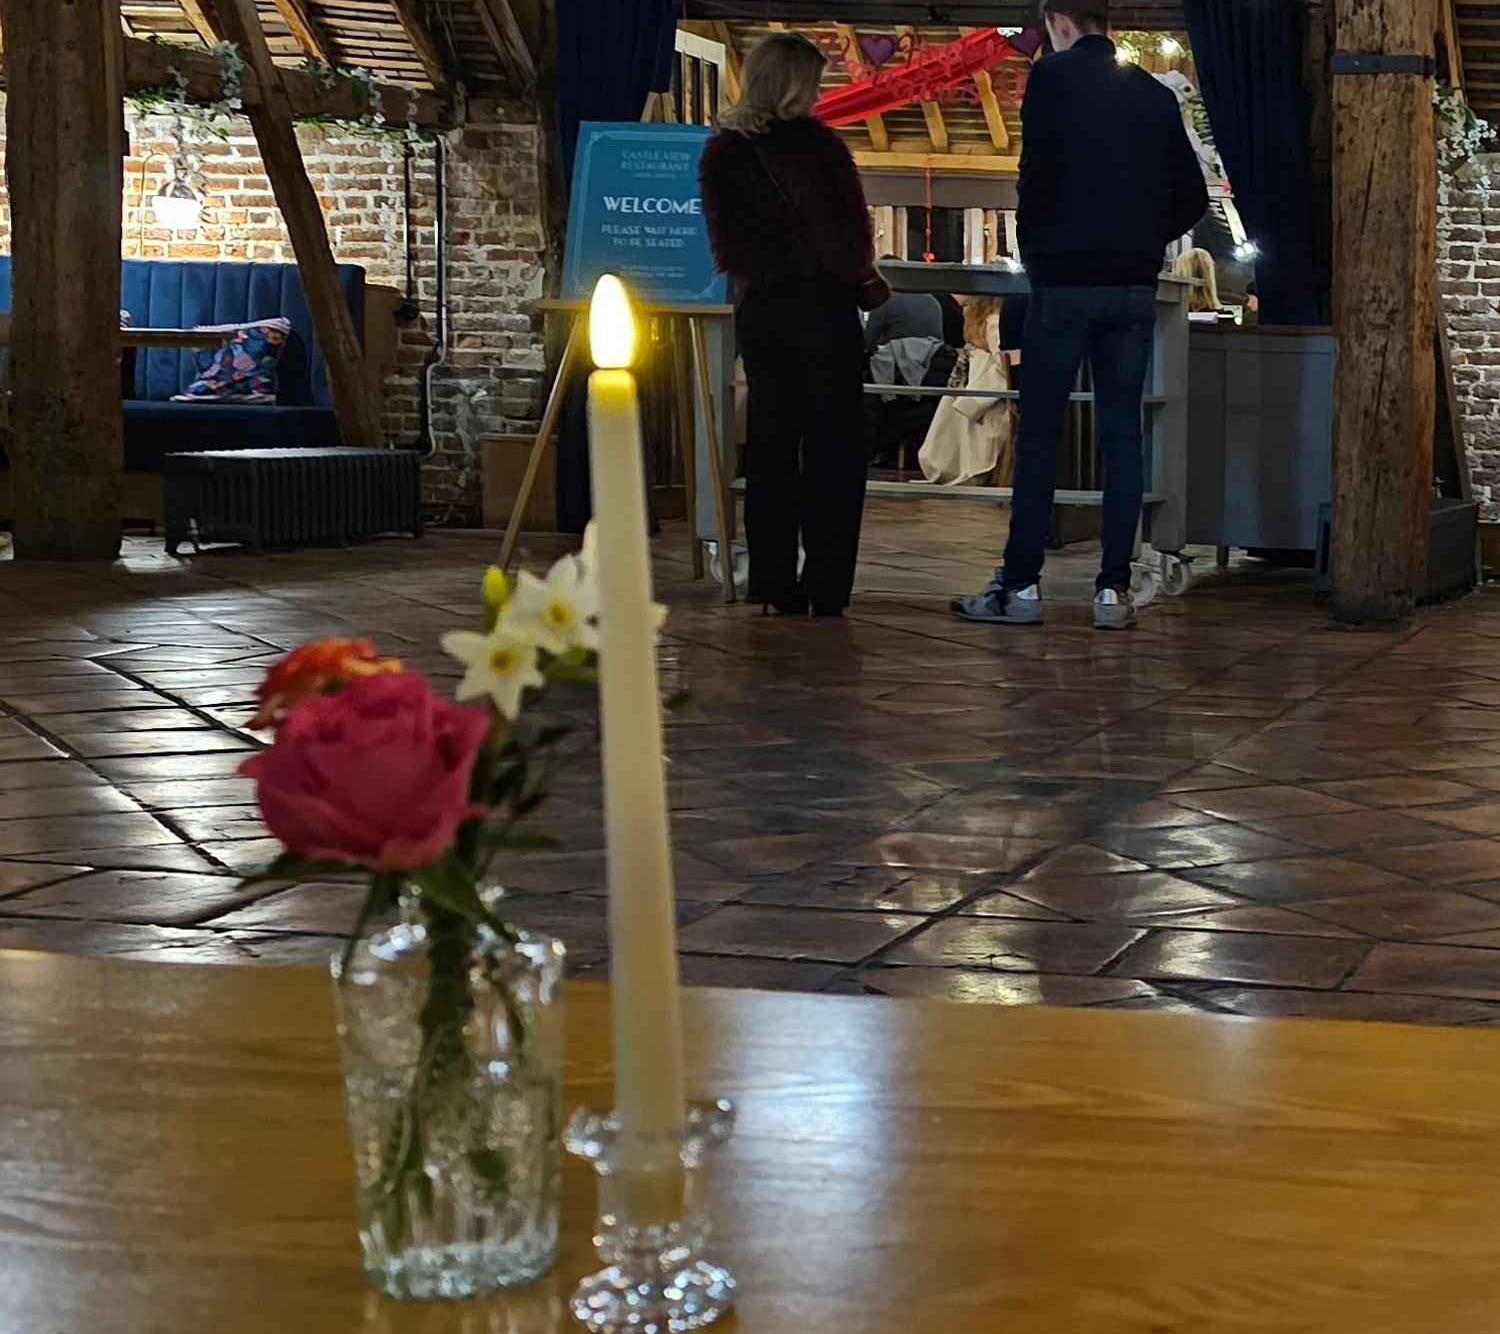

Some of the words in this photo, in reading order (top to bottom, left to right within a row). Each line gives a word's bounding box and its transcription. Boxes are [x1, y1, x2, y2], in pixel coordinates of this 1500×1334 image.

[621, 161, 690, 171] RESTAURANT
[603, 196, 703, 214] WELCOME
[601, 224, 641, 235] PLEASE
[643, 226, 667, 235] WAIT
[613, 237, 628, 246] TO
[629, 237, 642, 247] BE
[645, 238, 685, 248] SEATED
